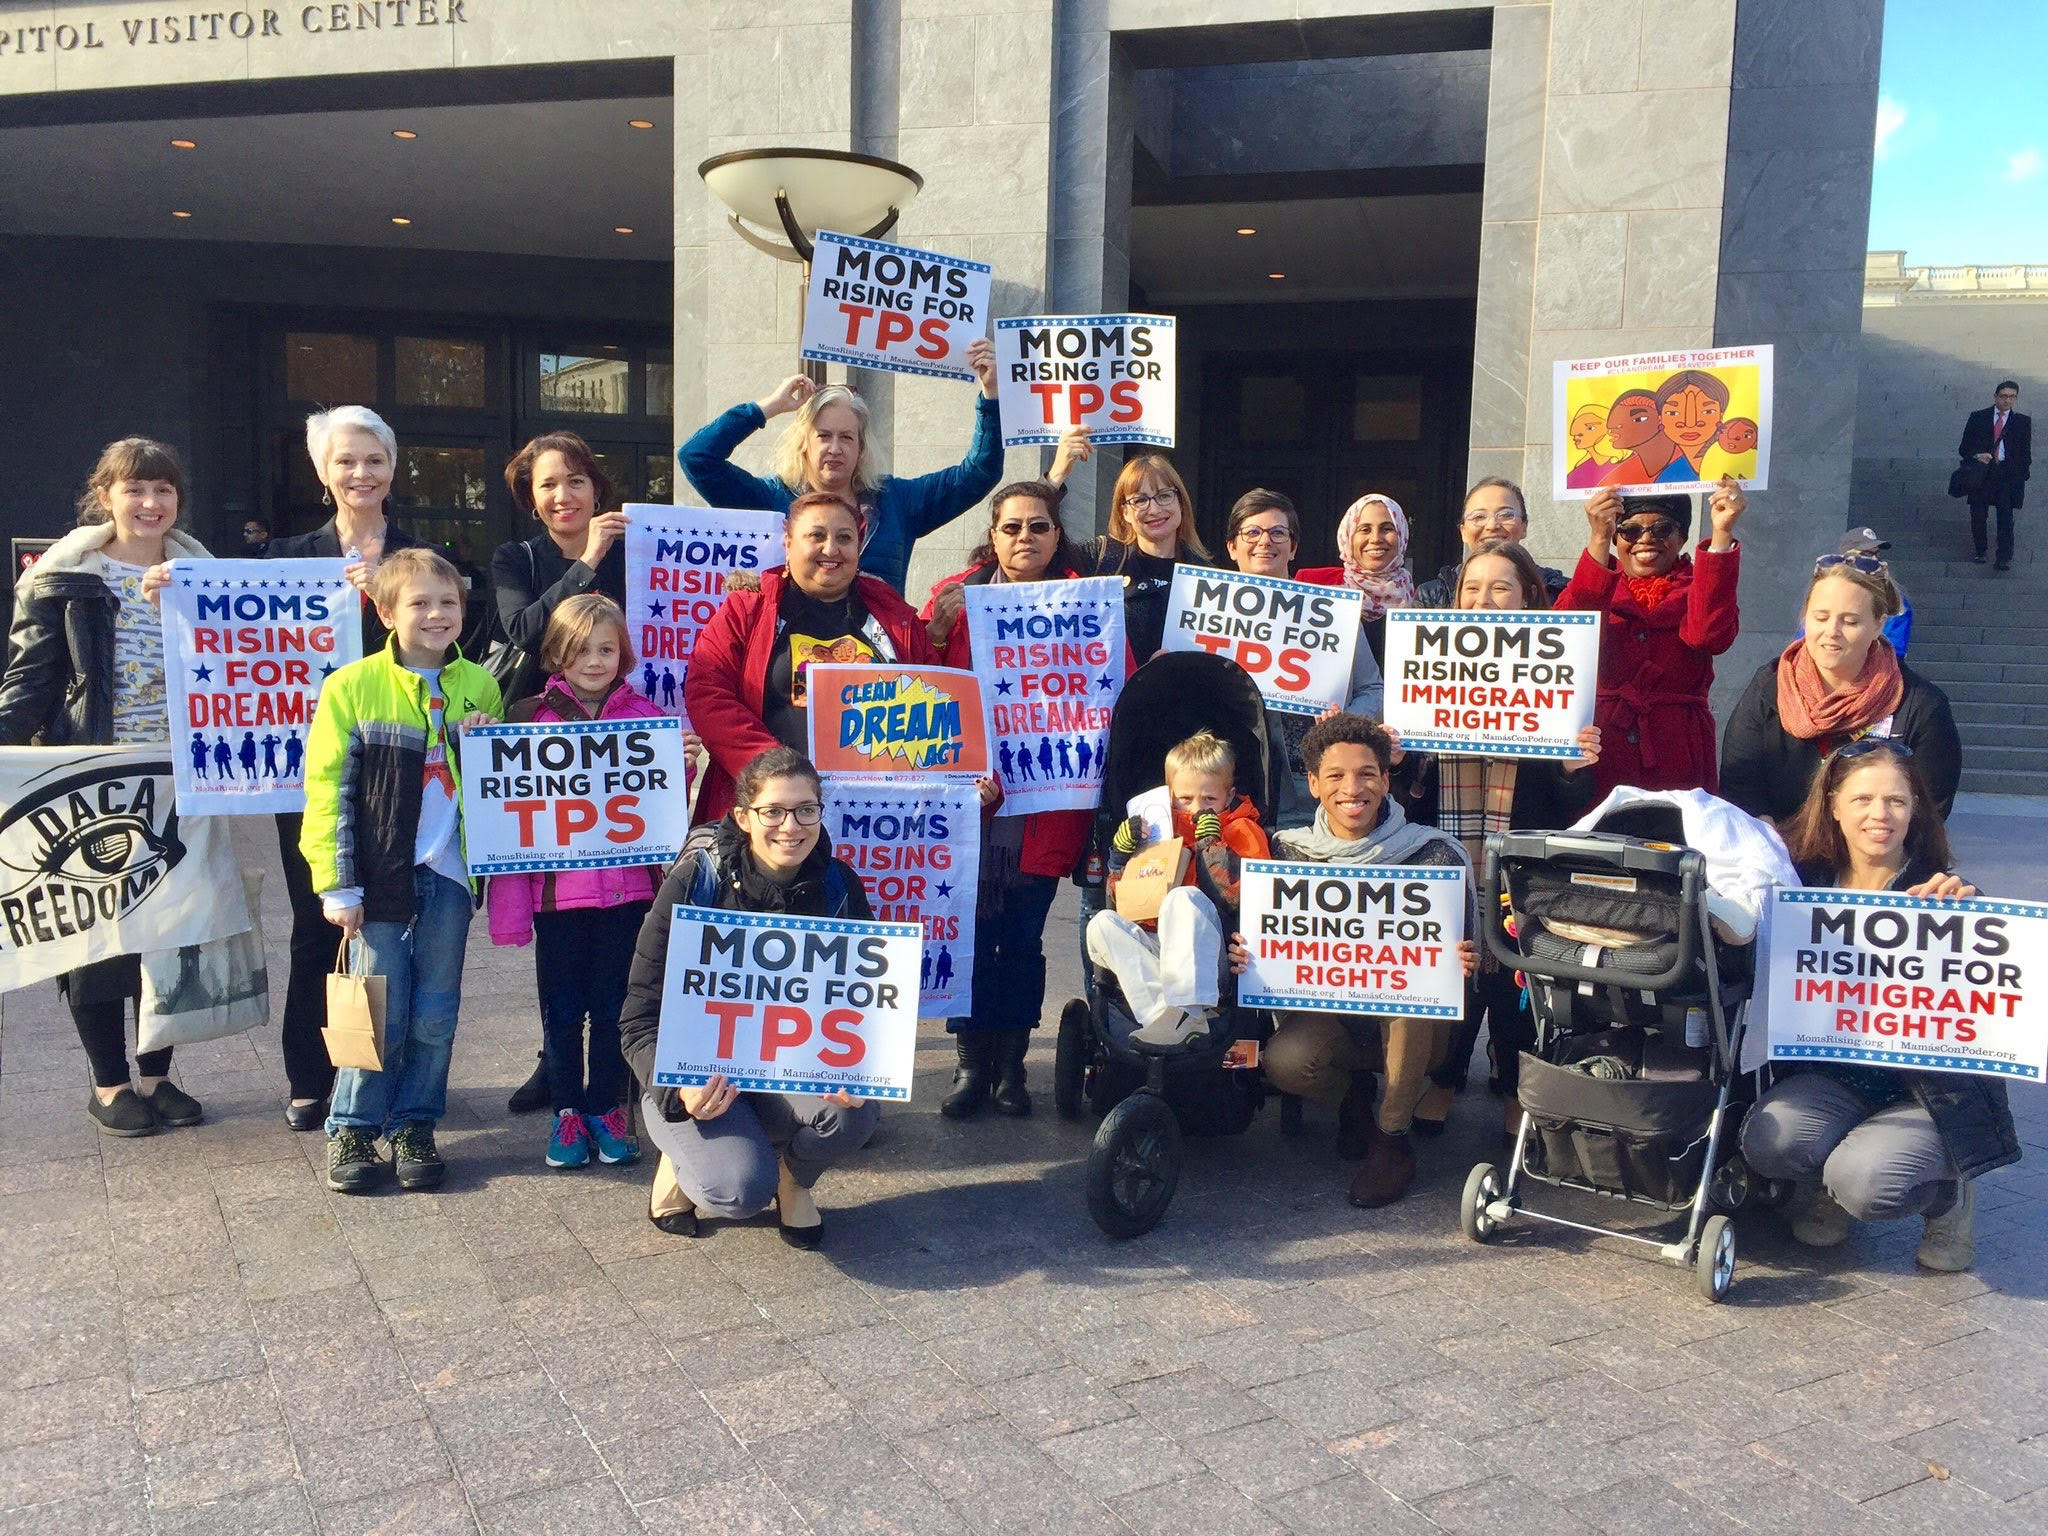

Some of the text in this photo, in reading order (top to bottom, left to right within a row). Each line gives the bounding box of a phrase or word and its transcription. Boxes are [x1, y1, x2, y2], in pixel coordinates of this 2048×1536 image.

[122, 9, 282, 46] VISITOR
[302, 0, 468, 33] CENTER
[836, 246, 968, 298] MOMS
[823, 278, 974, 323] RISING FOR
[839, 303, 951, 360] TPS
[1019, 326, 1153, 359] MOMS
[1011, 360, 1162, 382] RISING FOR
[1571, 349, 1755, 371] KEEP OUR FAMILIES TOGETHER
[1030, 380, 1143, 425] TPS
[1017, 427, 1063, 435] MomsRising
[656, 539, 759, 568] MOMS
[650, 567, 728, 595] RISIN
[197, 594, 329, 621] MOMS
[672, 599, 724, 624] FO
[1194, 579, 1334, 628] MOMS
[194, 625, 335, 654] RISING
[997, 614, 1101, 640] MOMS
[1179, 610, 1340, 653] RISING FOR
[994, 642, 1107, 669] RISING
[1415, 625, 1566, 659] MOMS
[226, 660, 311, 686] FOR
[1020, 673, 1088, 698] FOR
[1403, 660, 1575, 685] RISING FOR
[841, 680, 898, 705] CLEAN
[1402, 684, 1574, 709] IMMIGRANT
[189, 692, 318, 728] DREAME
[840, 701, 962, 748] DREAM
[993, 700, 1112, 736] DREAMER
[1434, 709, 1540, 732] RIGHTS
[1403, 729, 1470, 740] MomsRising.org
[491, 731, 655, 772] MOMS
[922, 742, 963, 767] ACT
[480, 769, 668, 798] RISING FOR
[27, 778, 155, 846] DACA
[504, 795, 645, 847] TPS
[841, 813, 950, 841] MOMS
[487, 851, 564, 861] MomsRising.org
[836, 844, 952, 871] RISING
[859, 875, 928, 902] FOR
[1272, 877, 1432, 916] MOMS
[0, 866, 160, 949] REEDOM
[1261, 914, 1442, 942] RISING FOR
[1811, 907, 2010, 956] MOMS
[700, 925, 889, 978] MOMS
[1260, 939, 1442, 967] IMMIGRANT
[1296, 965, 1408, 990] RIGHTS
[1796, 949, 2023, 990] RISING FOR
[682, 969, 899, 1009] RISING FOR
[1263, 986, 1335, 998] MomsRising.org
[1795, 979, 2023, 1018] IMMIGRANT
[705, 1001, 866, 1068] TPS
[1835, 1009, 1977, 1042] RIGHTS
[1796, 1033, 1884, 1048] MomsRising.org
[677, 1061, 767, 1077] MomsRising.org
